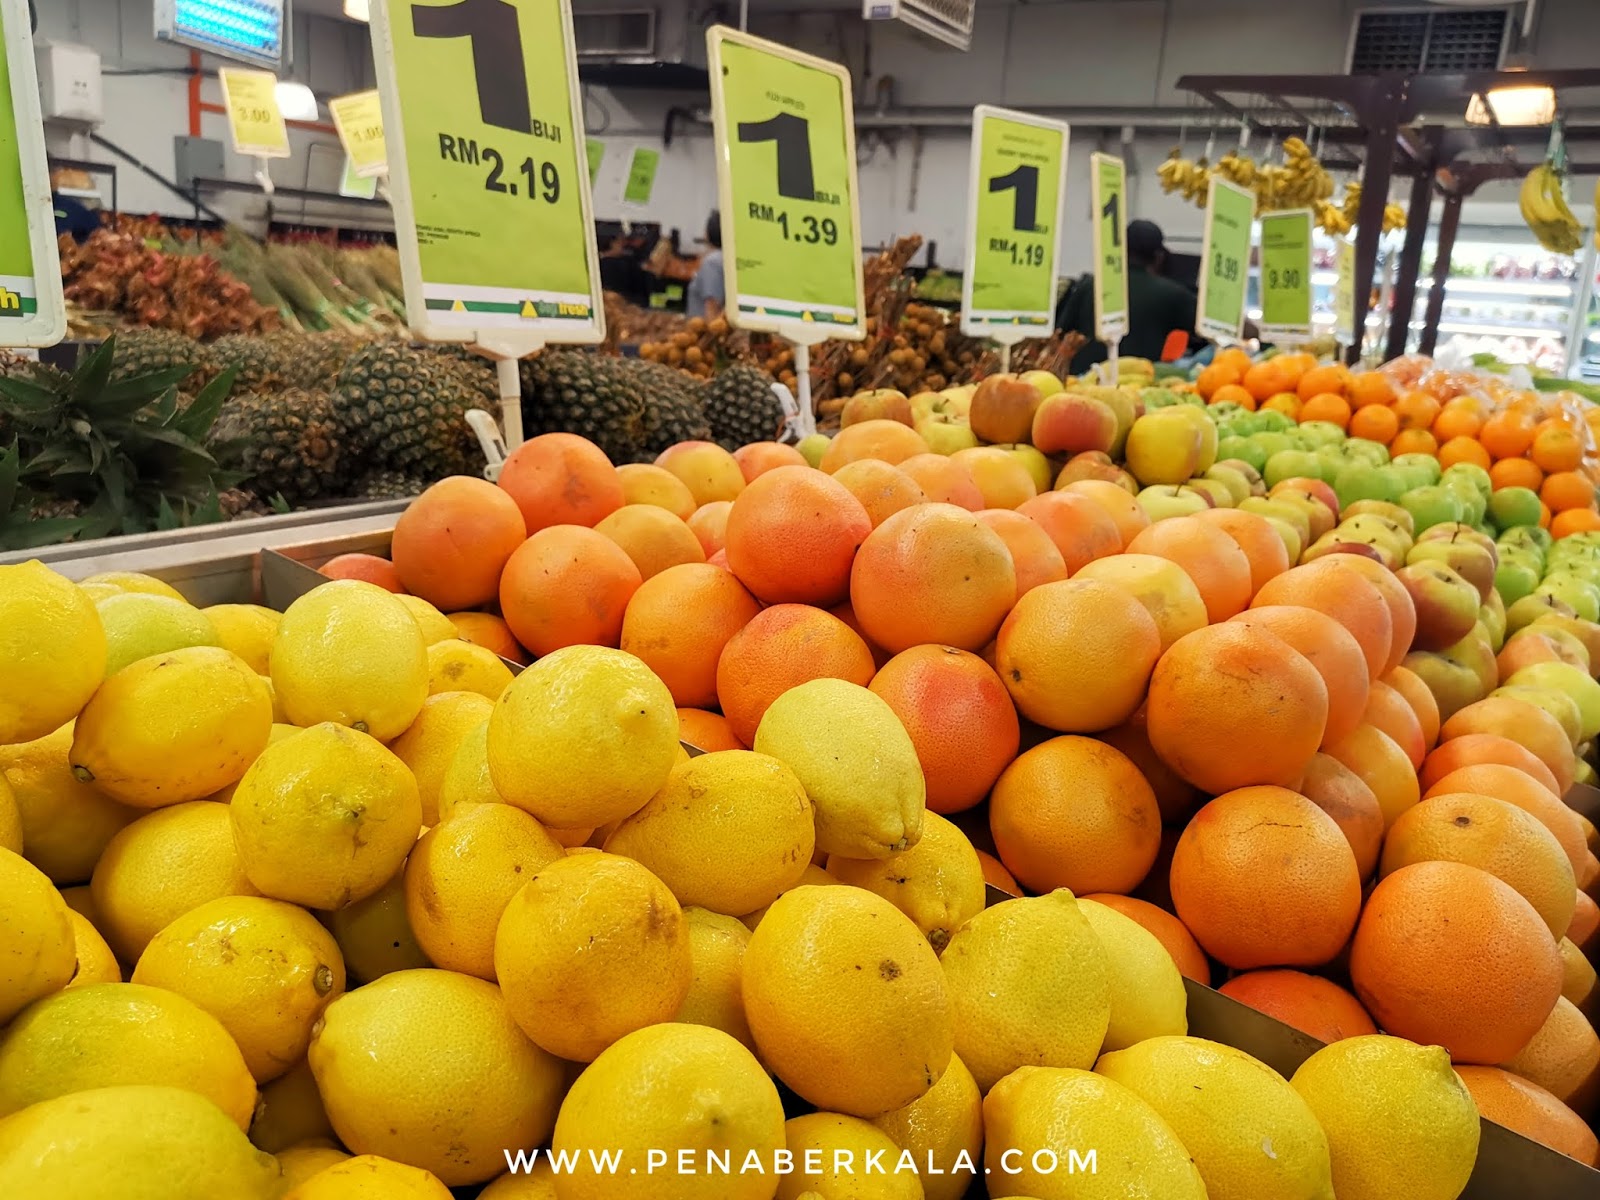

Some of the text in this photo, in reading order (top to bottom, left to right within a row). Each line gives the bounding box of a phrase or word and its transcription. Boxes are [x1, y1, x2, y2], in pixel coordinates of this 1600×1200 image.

[411, 0, 561, 143] 1 BIJI
[738, 112, 814, 201] 1
[989, 165, 1039, 232] 1
[1103, 192, 1121, 247] 1
